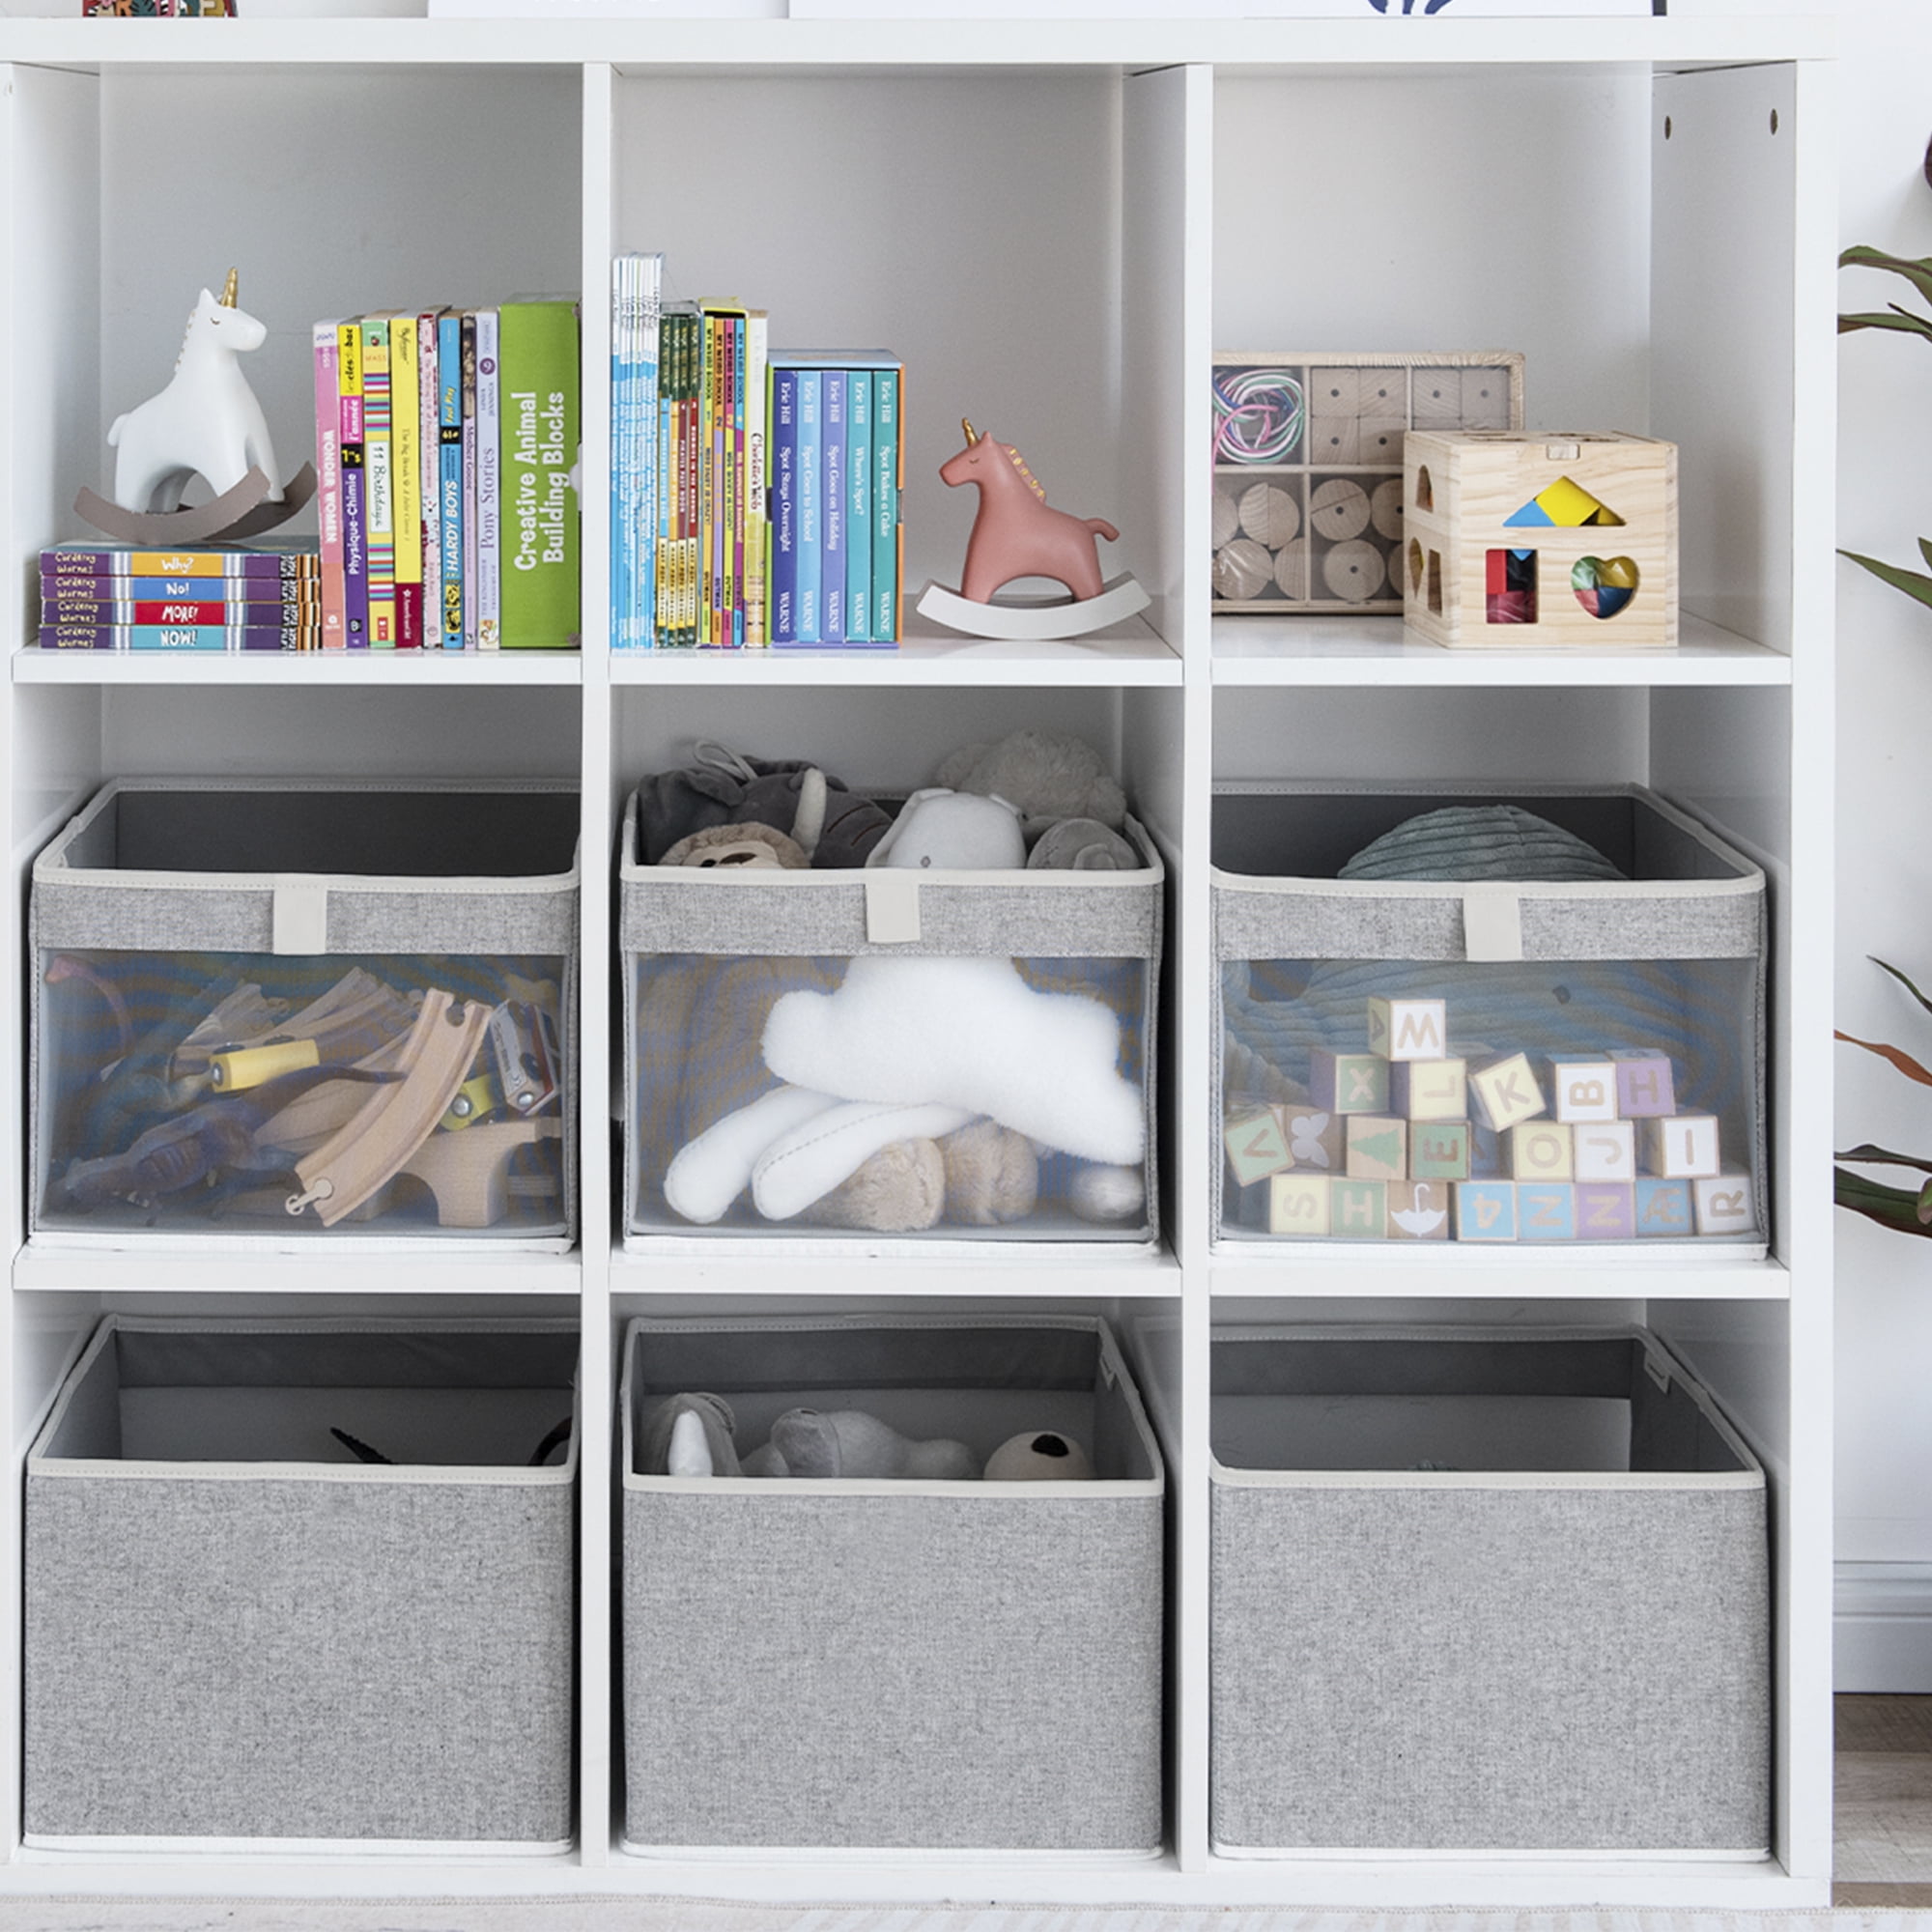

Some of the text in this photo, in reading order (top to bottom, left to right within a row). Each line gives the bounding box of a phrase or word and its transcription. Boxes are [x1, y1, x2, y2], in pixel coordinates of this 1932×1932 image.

[780, 382, 791, 424] Eric Hill
[804, 381, 814, 423] Eric Hill
[830, 381, 840, 423] Eric Hill
[855, 382, 866, 424] Eric Hill
[881, 381, 892, 423] Eric Hill
[538, 391, 570, 563] Building Blocks
[779, 446, 791, 469] Spot
[879, 445, 890, 467] Spot
[322, 431, 337, 543] WONDER WOMEN
[371, 465, 387, 526] Birthdays
[444, 480, 458, 518] BOYS
[479, 447, 498, 549] Pony Stories
[510, 391, 537, 571] Creative Animal
[801, 445, 813, 542] Spot Goes to School
[826, 444, 839, 551] Spot Goes on Holiday
[852, 446, 866, 516] Where's Spot?
[880, 470, 891, 500] Bakes
[346, 473, 361, 575] Physique-Chimie
[779, 501, 792, 553] Overnight
[880, 512, 890, 537] Cake
[161, 557, 194, 574] Why?
[445, 521, 459, 571] HARDY
[165, 582, 190, 595] No!
[161, 608, 198, 623] MORE!
[779, 591, 790, 634] WARNE
[803, 590, 813, 632] WARNE
[829, 590, 839, 633] WARNE
[854, 592, 865, 634] WARNE
[880, 591, 891, 633] WARNE
[160, 631, 197, 646] NOW!
[1349, 1066, 1375, 1102] X
[1423, 1074, 1456, 1098] L
[1493, 1070, 1530, 1114] K
[1569, 1079, 1605, 1107] B
[1629, 1068, 1659, 1106] H
[1423, 1138, 1459, 1162] E
[1526, 1133, 1562, 1168] O
[1585, 1137, 1622, 1165] J
[1283, 1192, 1318, 1219] S
[1344, 1189, 1373, 1226] H
[1709, 1189, 1747, 1218] R
